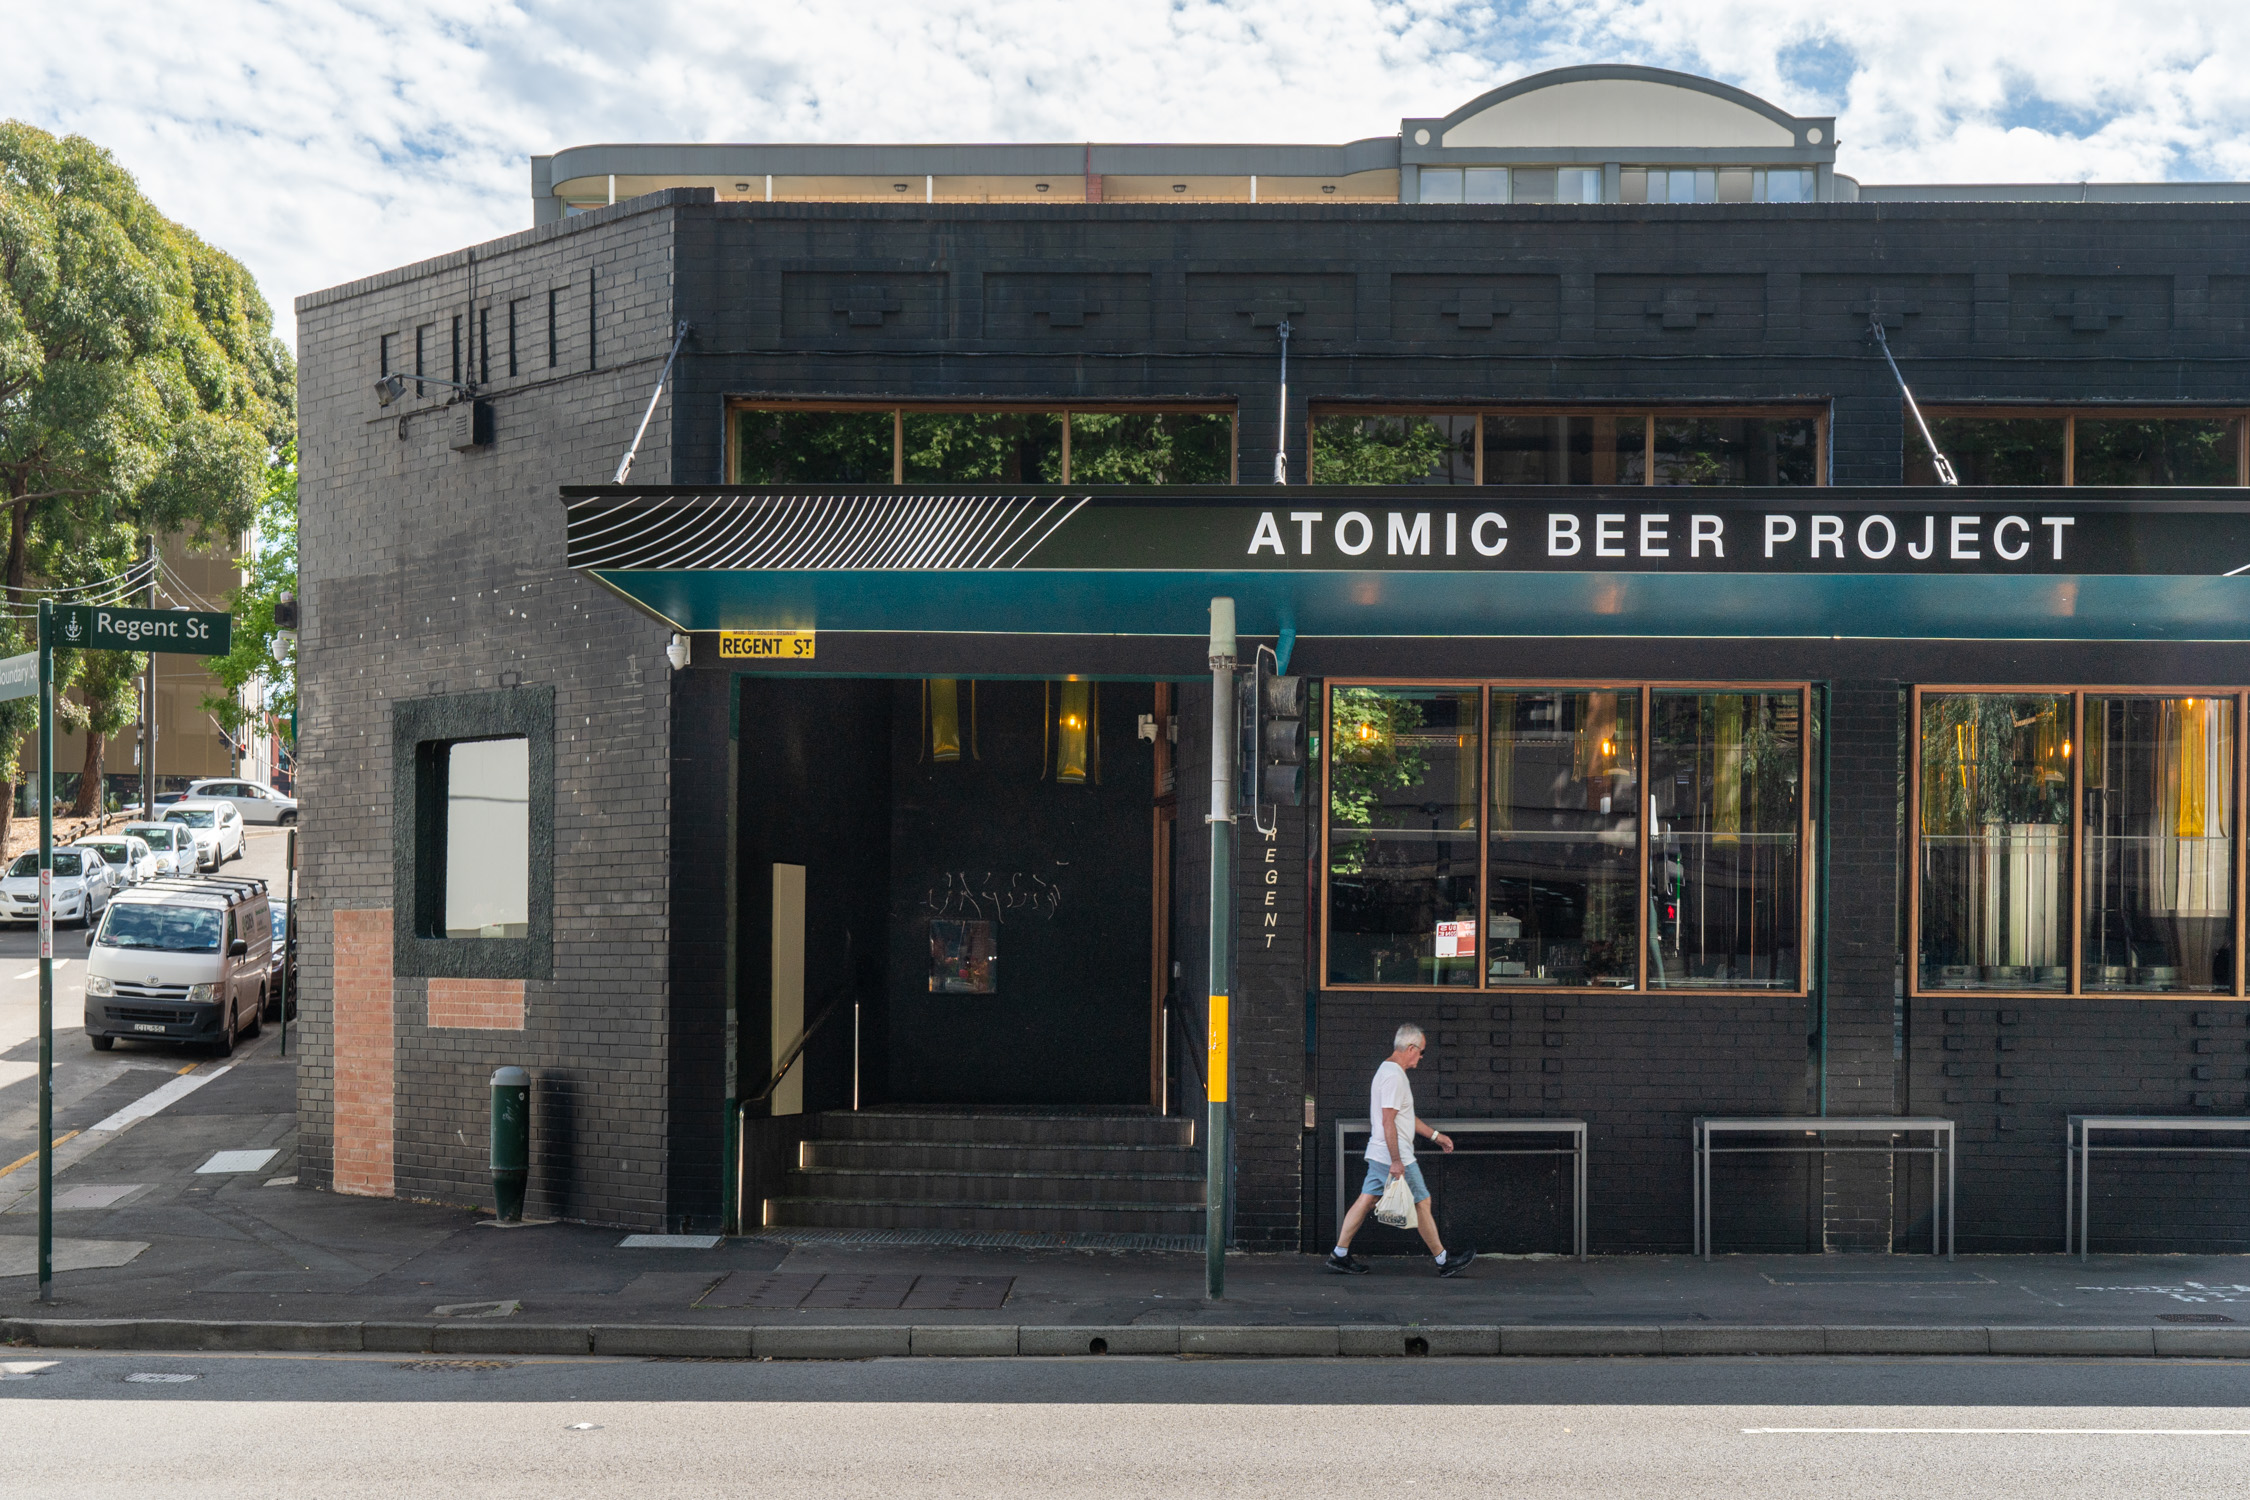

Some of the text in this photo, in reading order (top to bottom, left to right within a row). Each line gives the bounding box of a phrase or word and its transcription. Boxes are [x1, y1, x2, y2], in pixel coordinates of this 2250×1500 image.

[1247, 511, 2075, 560] ATOMIC BEER PROJECT
[97, 612, 209, 641] Regent St
[722, 638, 783, 654] REGENT
[30, 659, 37, 679] St
[1264, 827, 1278, 948] REGENT
